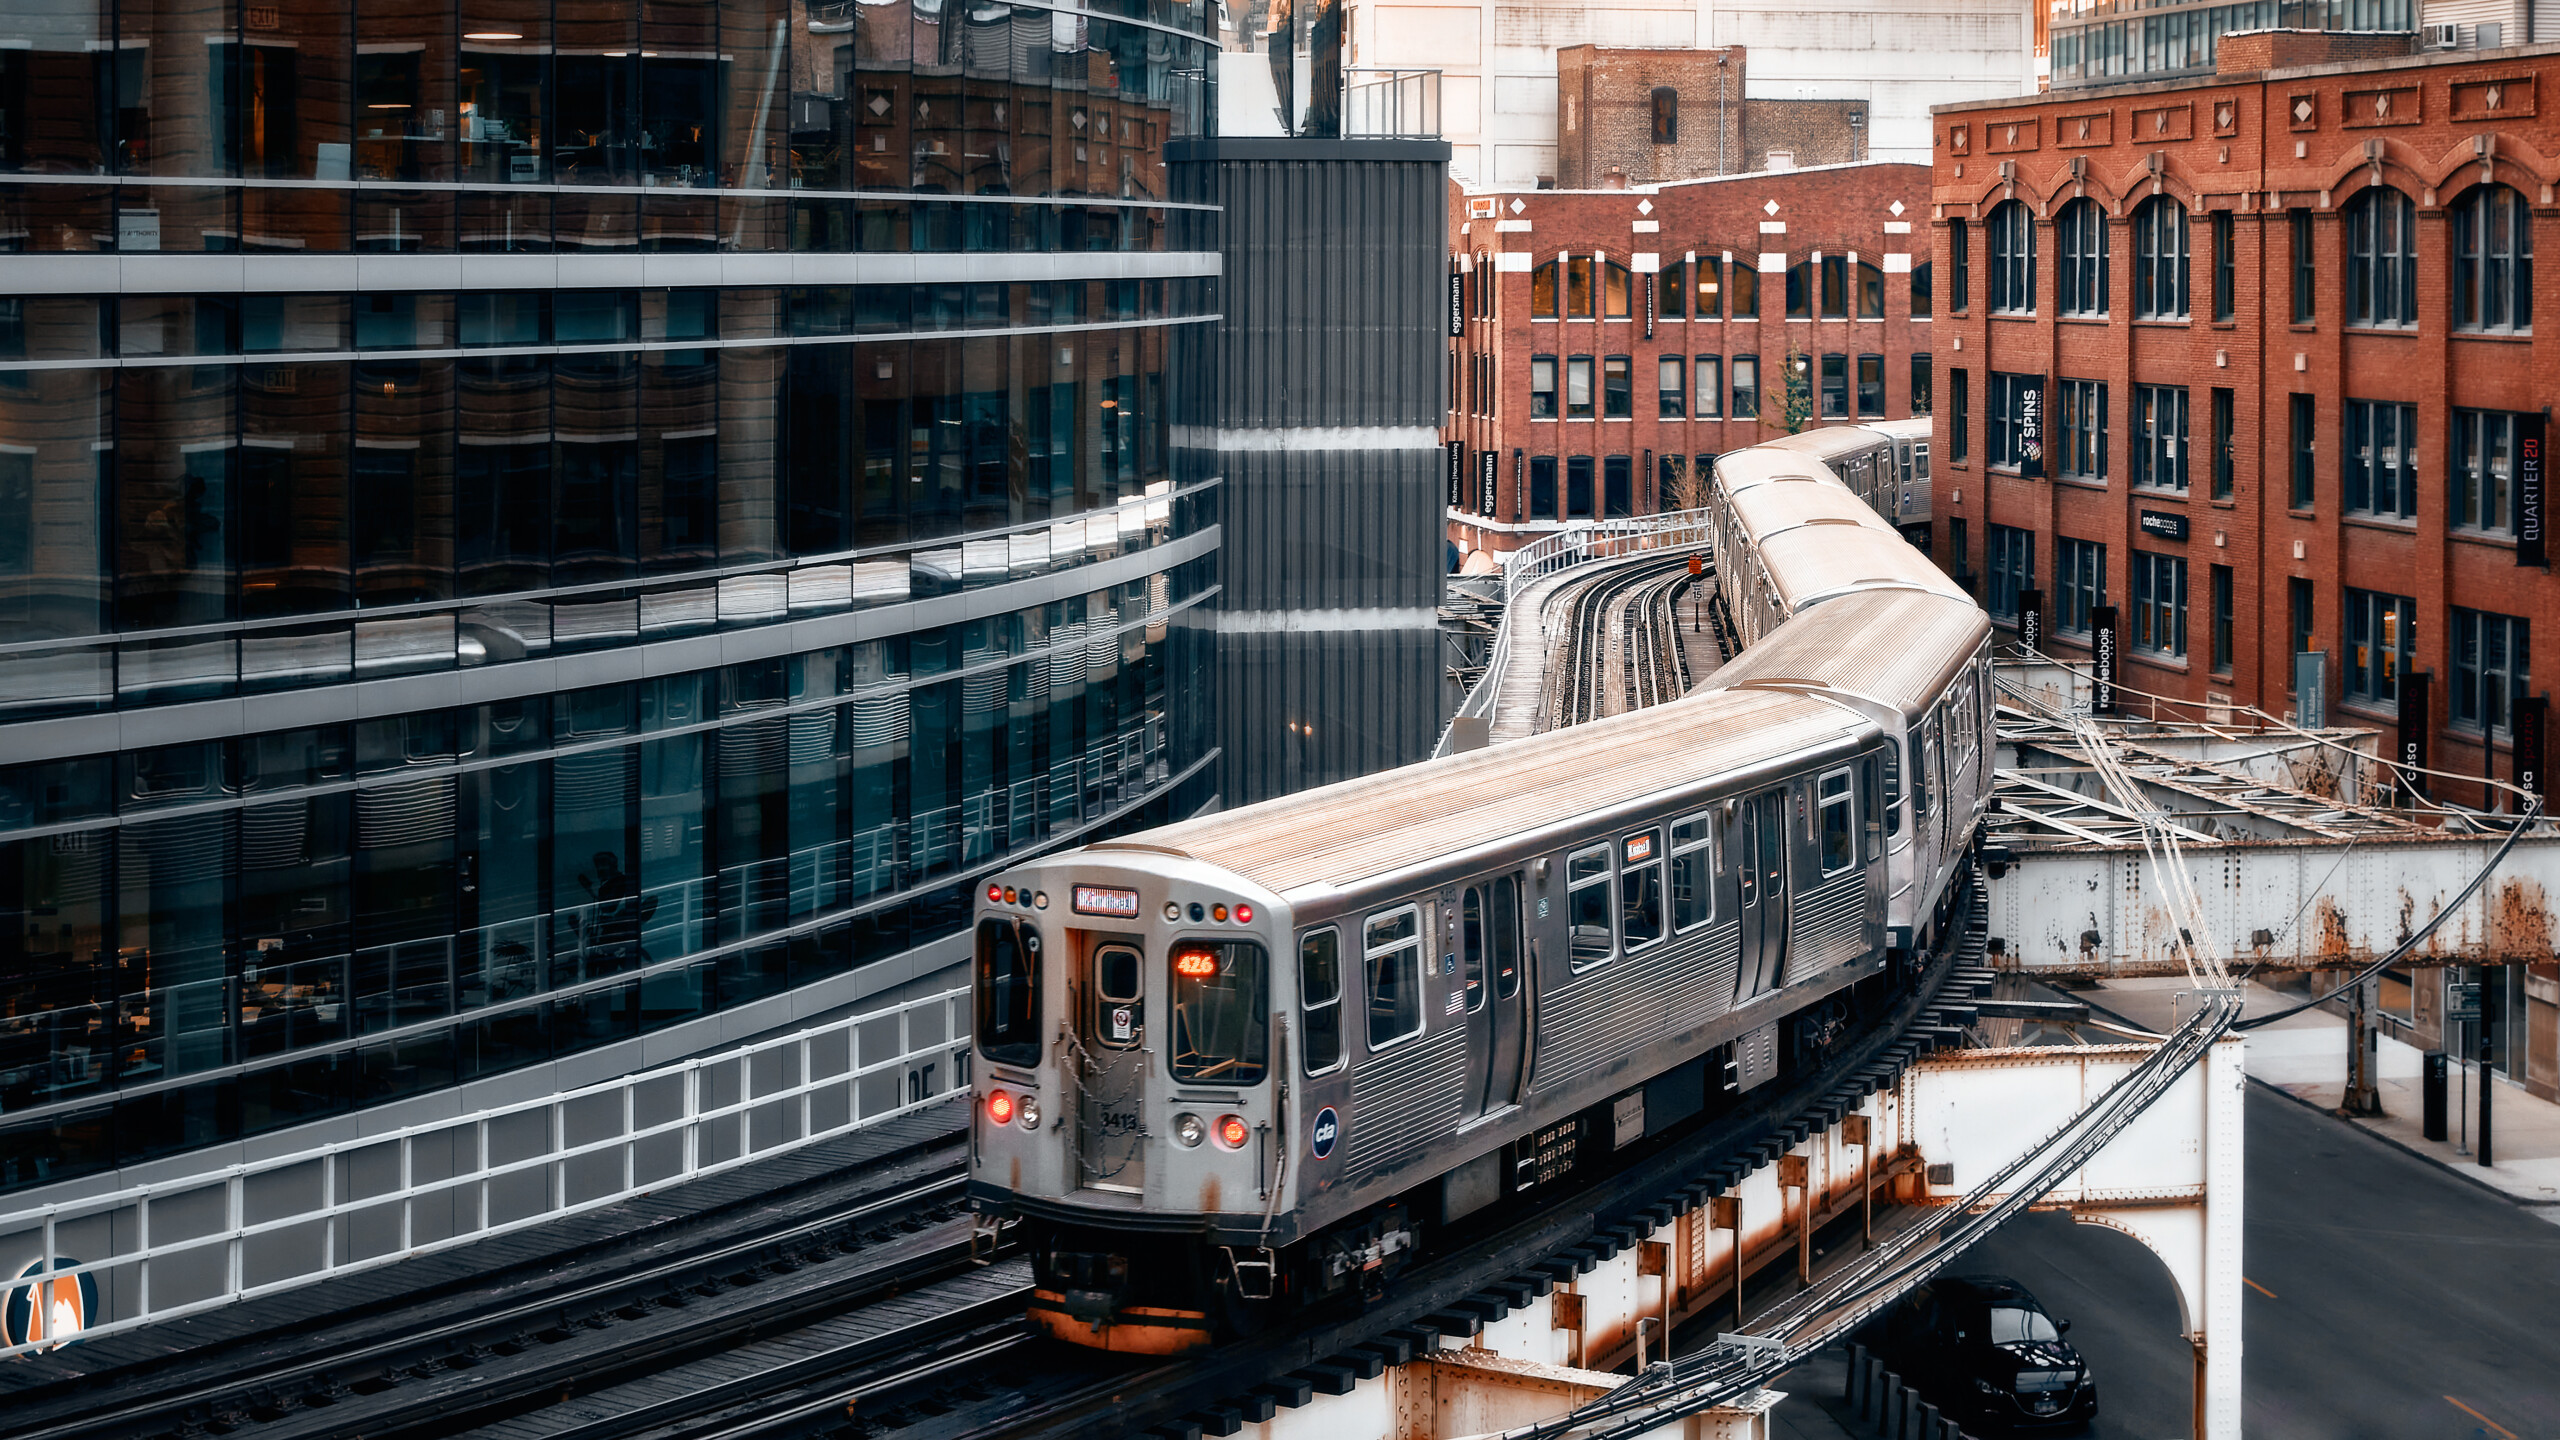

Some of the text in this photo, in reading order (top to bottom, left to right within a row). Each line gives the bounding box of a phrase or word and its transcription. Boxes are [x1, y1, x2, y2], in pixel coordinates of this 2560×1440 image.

[250, 8, 275, 24] EXIT
[1452, 277, 1462, 334] eggersmann
[267, 371, 292, 387] EXIT
[2023, 389, 2036, 438] SPINS
[1452, 442, 1460, 460] Living
[1485, 454, 1494, 513] eggersmann
[1692, 591, 1702, 599] 15
[53, 831, 84, 850] EXIT
[1178, 956, 1214, 973] 426
[1101, 1112, 1137, 1130] 3413
[1315, 1123, 1335, 1142] cta
